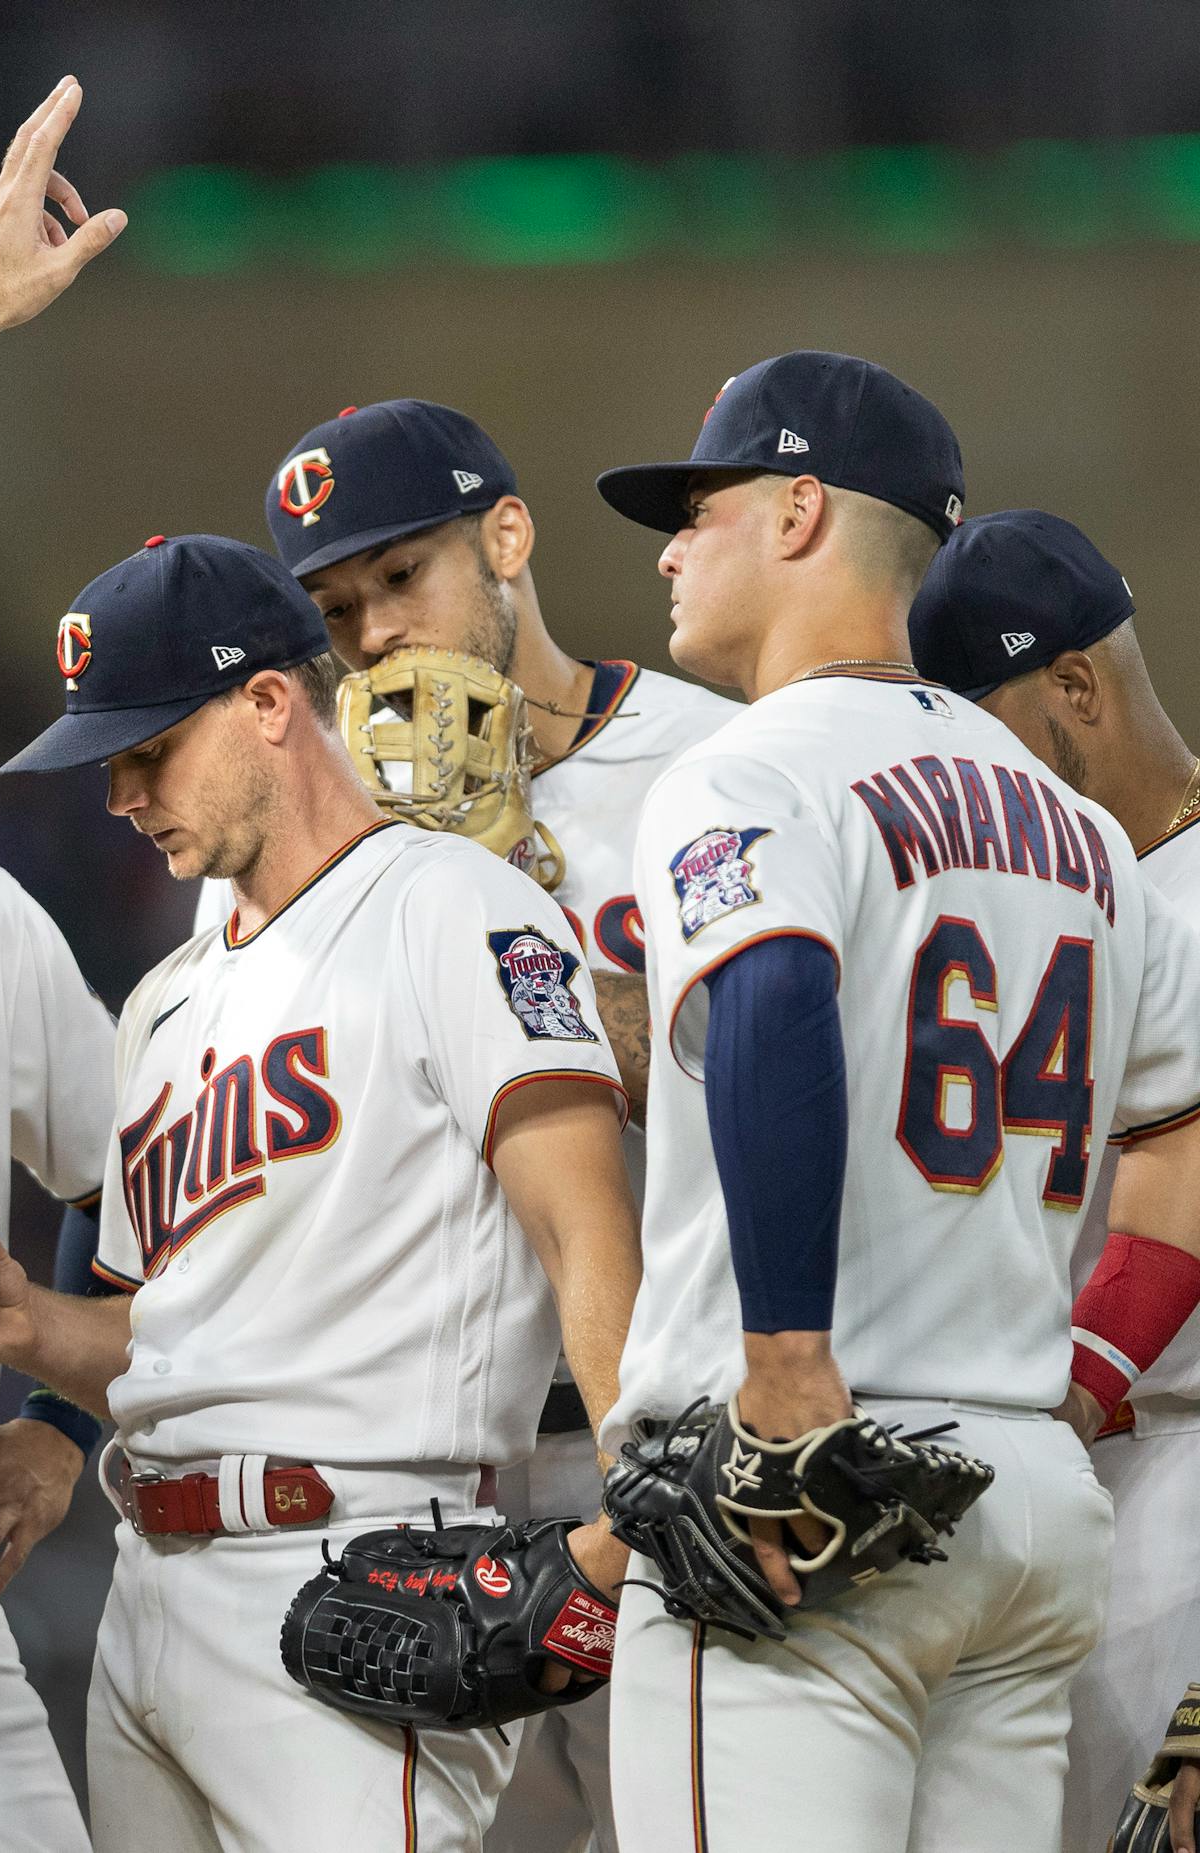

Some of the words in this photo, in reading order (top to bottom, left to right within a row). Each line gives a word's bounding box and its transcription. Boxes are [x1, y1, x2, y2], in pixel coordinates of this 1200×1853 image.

[675, 836, 740, 884] Twins
[850, 754, 1116, 928] MIRANDA
[501, 948, 563, 980] Twins
[895, 914, 1095, 1213] 64
[119, 1026, 343, 1281] Twins
[274, 1485, 308, 1512] 54
[561, 1621, 615, 1659] awlings
